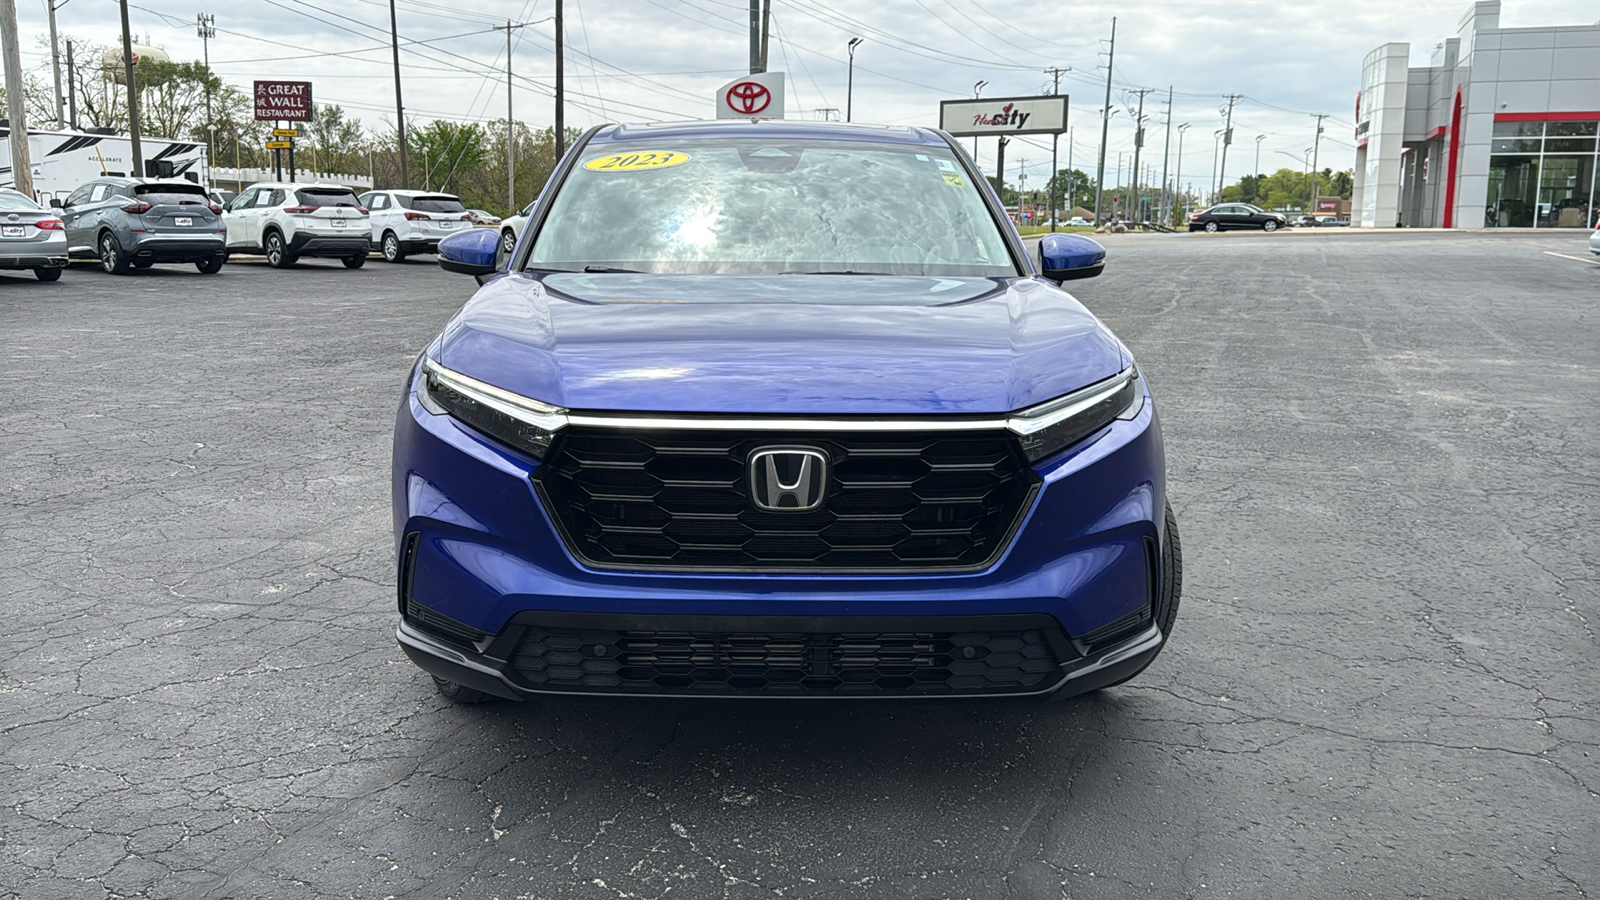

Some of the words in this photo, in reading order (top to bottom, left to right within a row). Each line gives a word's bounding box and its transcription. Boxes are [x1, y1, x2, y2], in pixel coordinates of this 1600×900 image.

[268, 84, 305, 95] GREAT
[269, 97, 304, 107] WALL
[992, 109, 1031, 129] city
[600, 153, 674, 169] 2023
